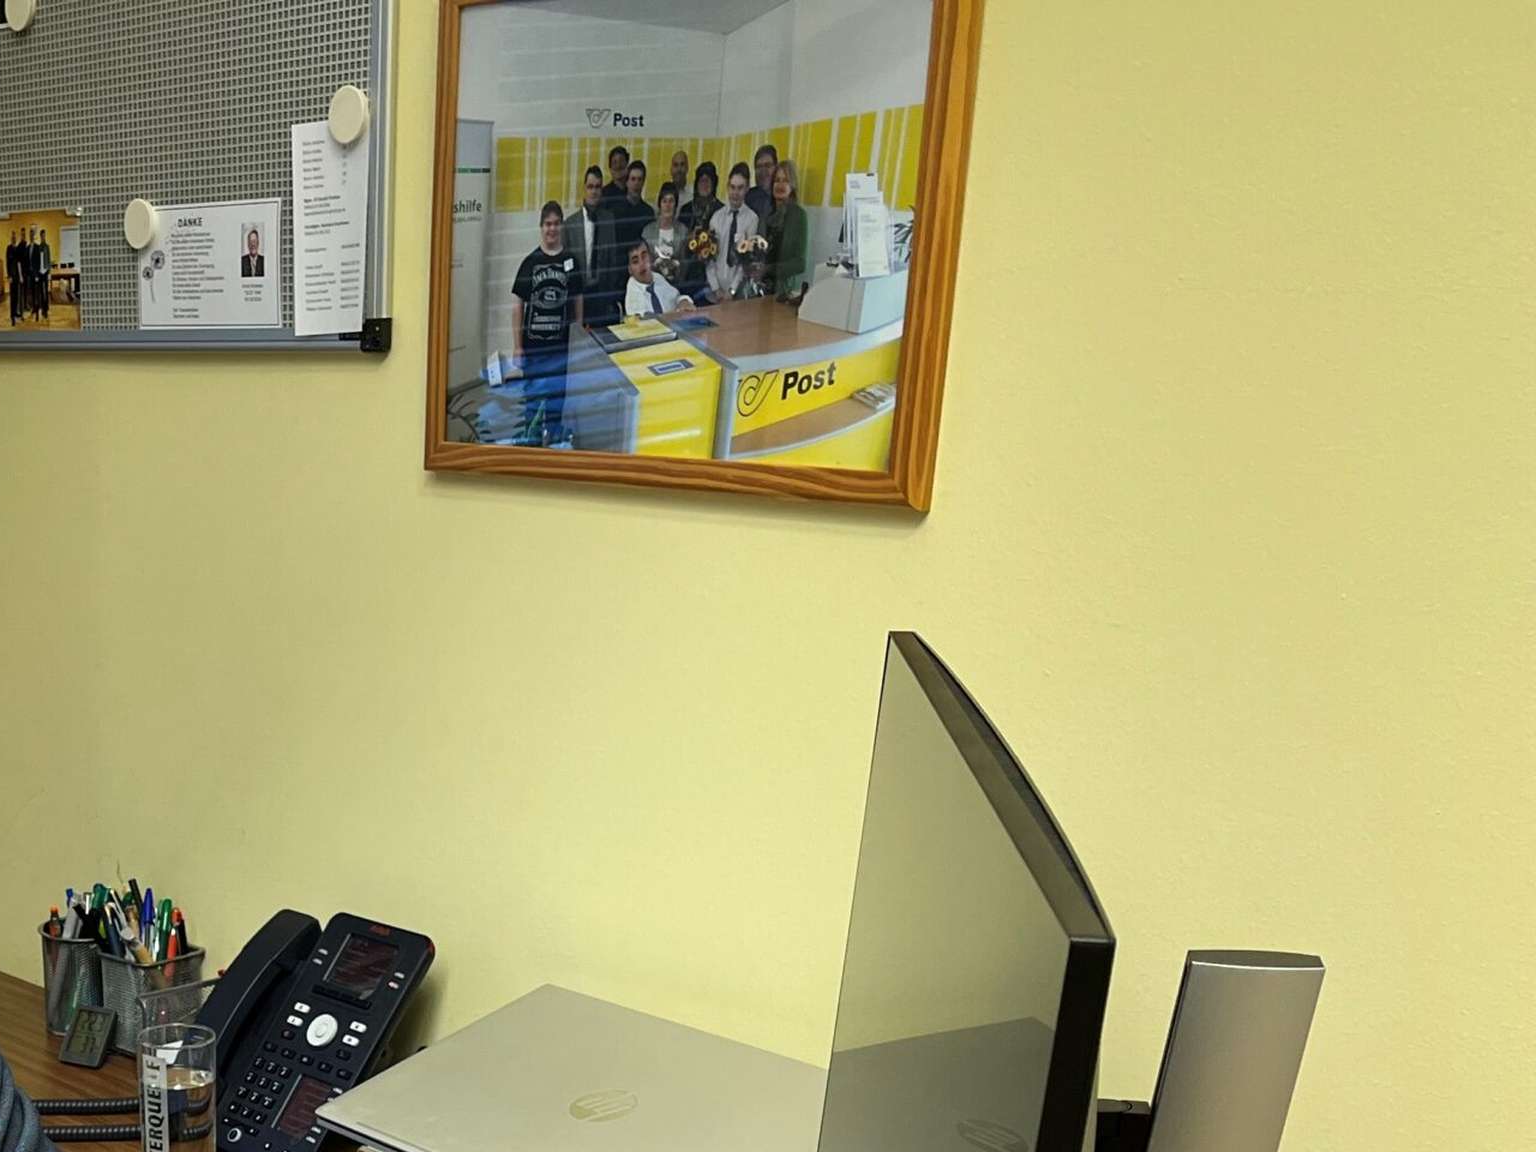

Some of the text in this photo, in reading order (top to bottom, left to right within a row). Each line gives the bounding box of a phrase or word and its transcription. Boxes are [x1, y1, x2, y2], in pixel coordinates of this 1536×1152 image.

[613, 112, 644, 127] Post
[177, 217, 203, 228] DANKE
[781, 362, 836, 401] Post
